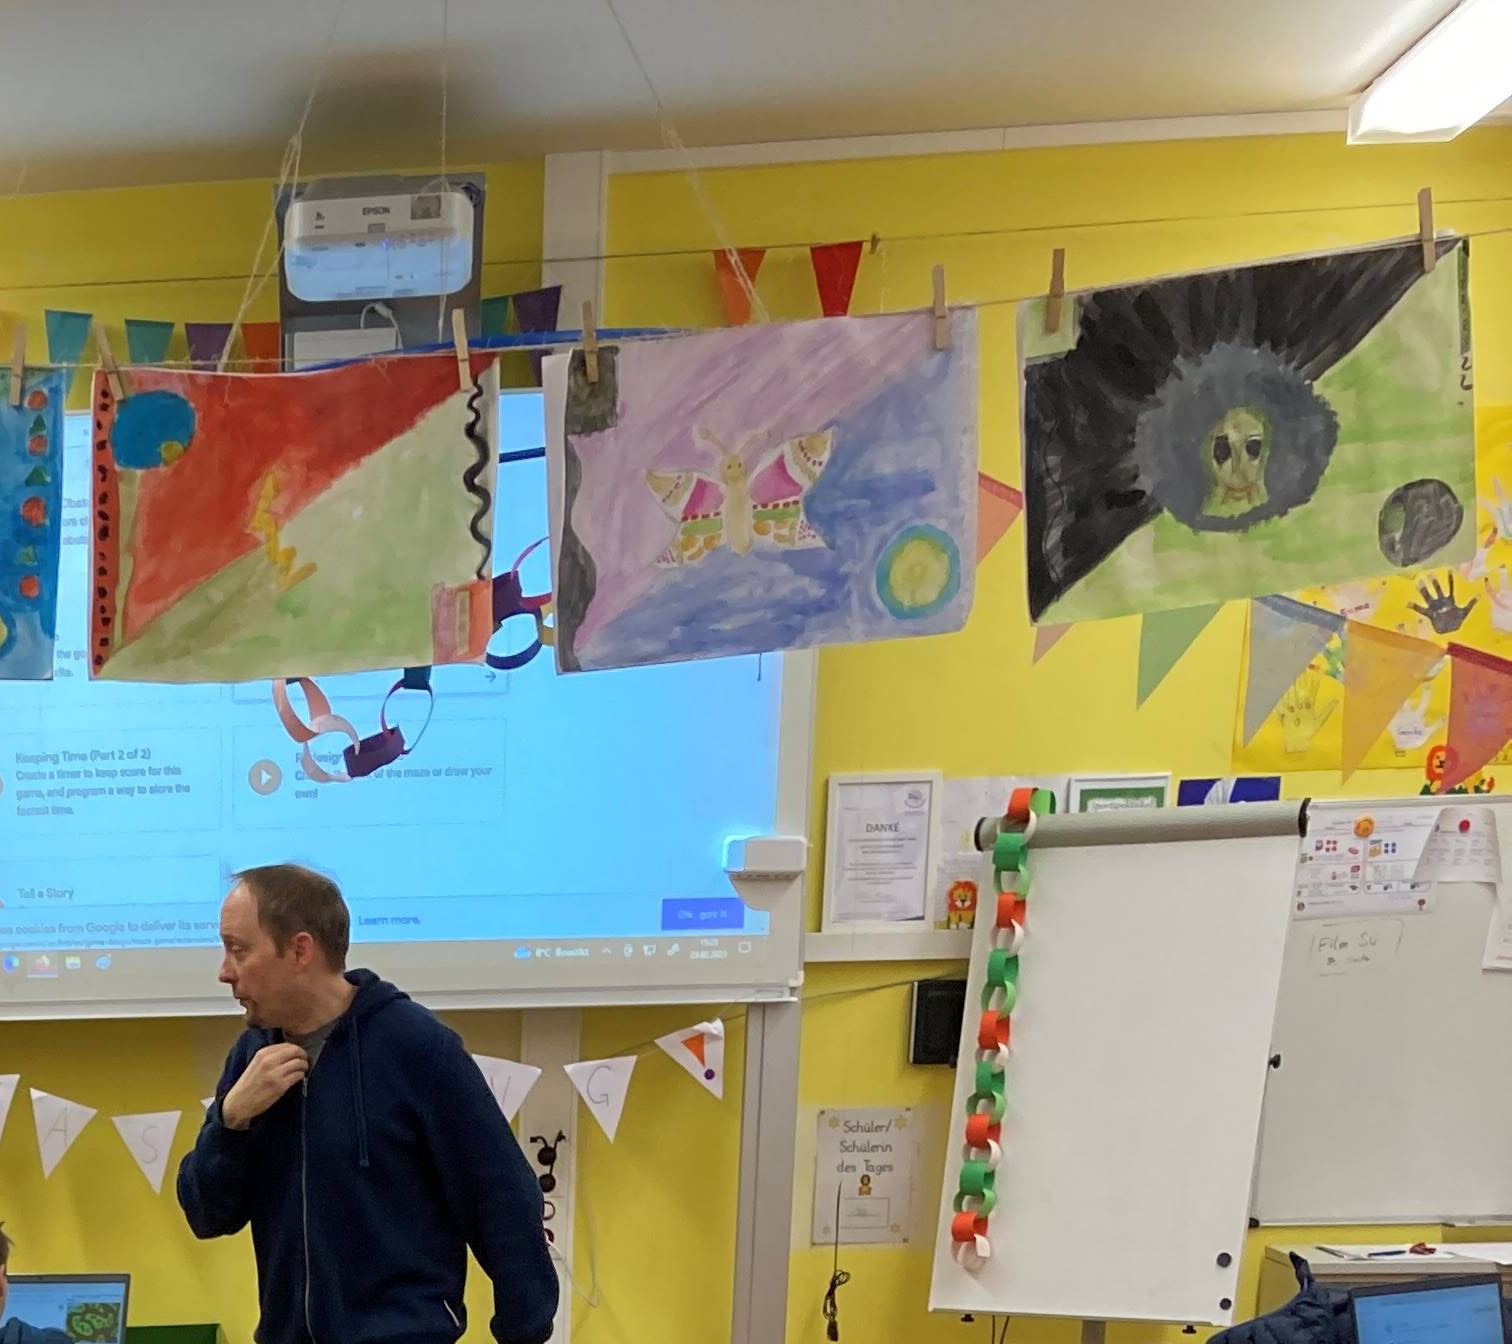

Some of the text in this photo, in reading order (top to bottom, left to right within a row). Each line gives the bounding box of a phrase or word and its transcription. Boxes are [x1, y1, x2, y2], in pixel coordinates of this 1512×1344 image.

[362, 206, 390, 216] EPSON
[16, 752, 59, 765] Keeping
[61, 751, 88, 762] Time
[90, 749, 115, 762] (Part
[126, 750, 139, 760] of
[140, 749, 151, 760] 2)
[16, 769, 47, 780] Create
[57, 769, 81, 780] timer
[83, 768, 93, 778] to
[95, 767, 118, 779] keep
[119, 768, 146, 778] score
[148, 766, 162, 777] for
[163, 765, 182, 776] this
[387, 768, 401, 778] the
[404, 769, 430, 778] maze
[445, 766, 468, 776] draw
[470, 767, 492, 778] your
[16, 788, 45, 800] game,
[47, 787, 65, 797] and
[66, 787, 106, 799] program
[116, 786, 135, 797] way
[149, 784, 173, 794] store
[175, 783, 190, 793] the
[51, 804, 74, 815] time.
[866, 822, 900, 833] DANKE
[17, 888, 36, 899] Tell
[45, 888, 75, 900] Story
[359, 915, 422, 926] Learn more.
[16, 924, 56, 935] cookies
[58, 923, 83, 934] from
[86, 922, 125, 936] Google
[127, 922, 138, 933] to
[141, 921, 176, 932] deliver
[178, 920, 192, 931] its
[839, 1139, 893, 1153] Schülerin
[837, 1159, 894, 1176] des Tages
